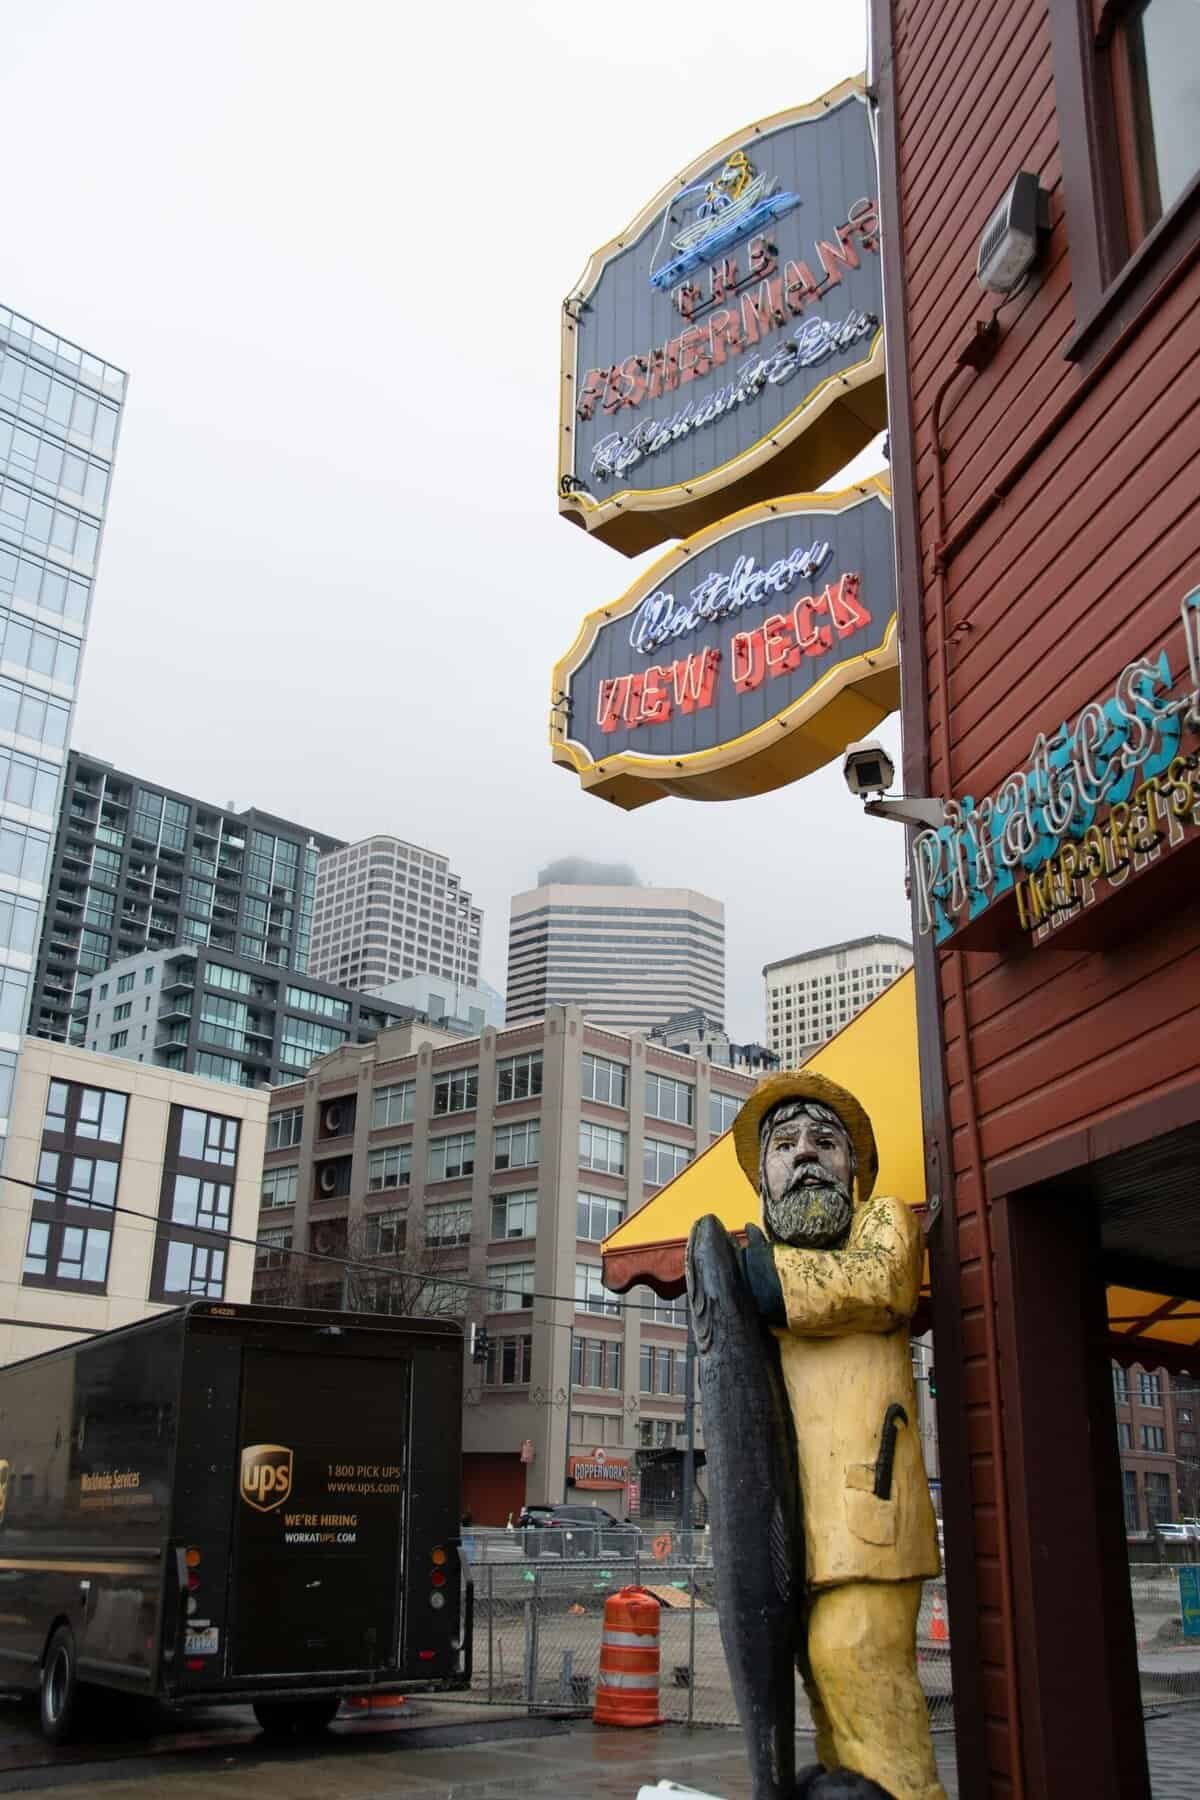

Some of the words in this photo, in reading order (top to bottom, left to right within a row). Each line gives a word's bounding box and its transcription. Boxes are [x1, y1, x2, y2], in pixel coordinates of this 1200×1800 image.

[597, 646, 721, 734] VIEW
[730, 572, 872, 695] DECK
[1015, 755, 1200, 948] IMPORTS
[357, 1466, 379, 1478] PICK
[575, 1463, 627, 1481] COPPERWORKS
[243, 1464, 290, 1502] ups
[327, 1482, 401, 1496] www.ups.com
[285, 1514, 318, 1526] WE'RE
[320, 1514, 357, 1527] HIRING
